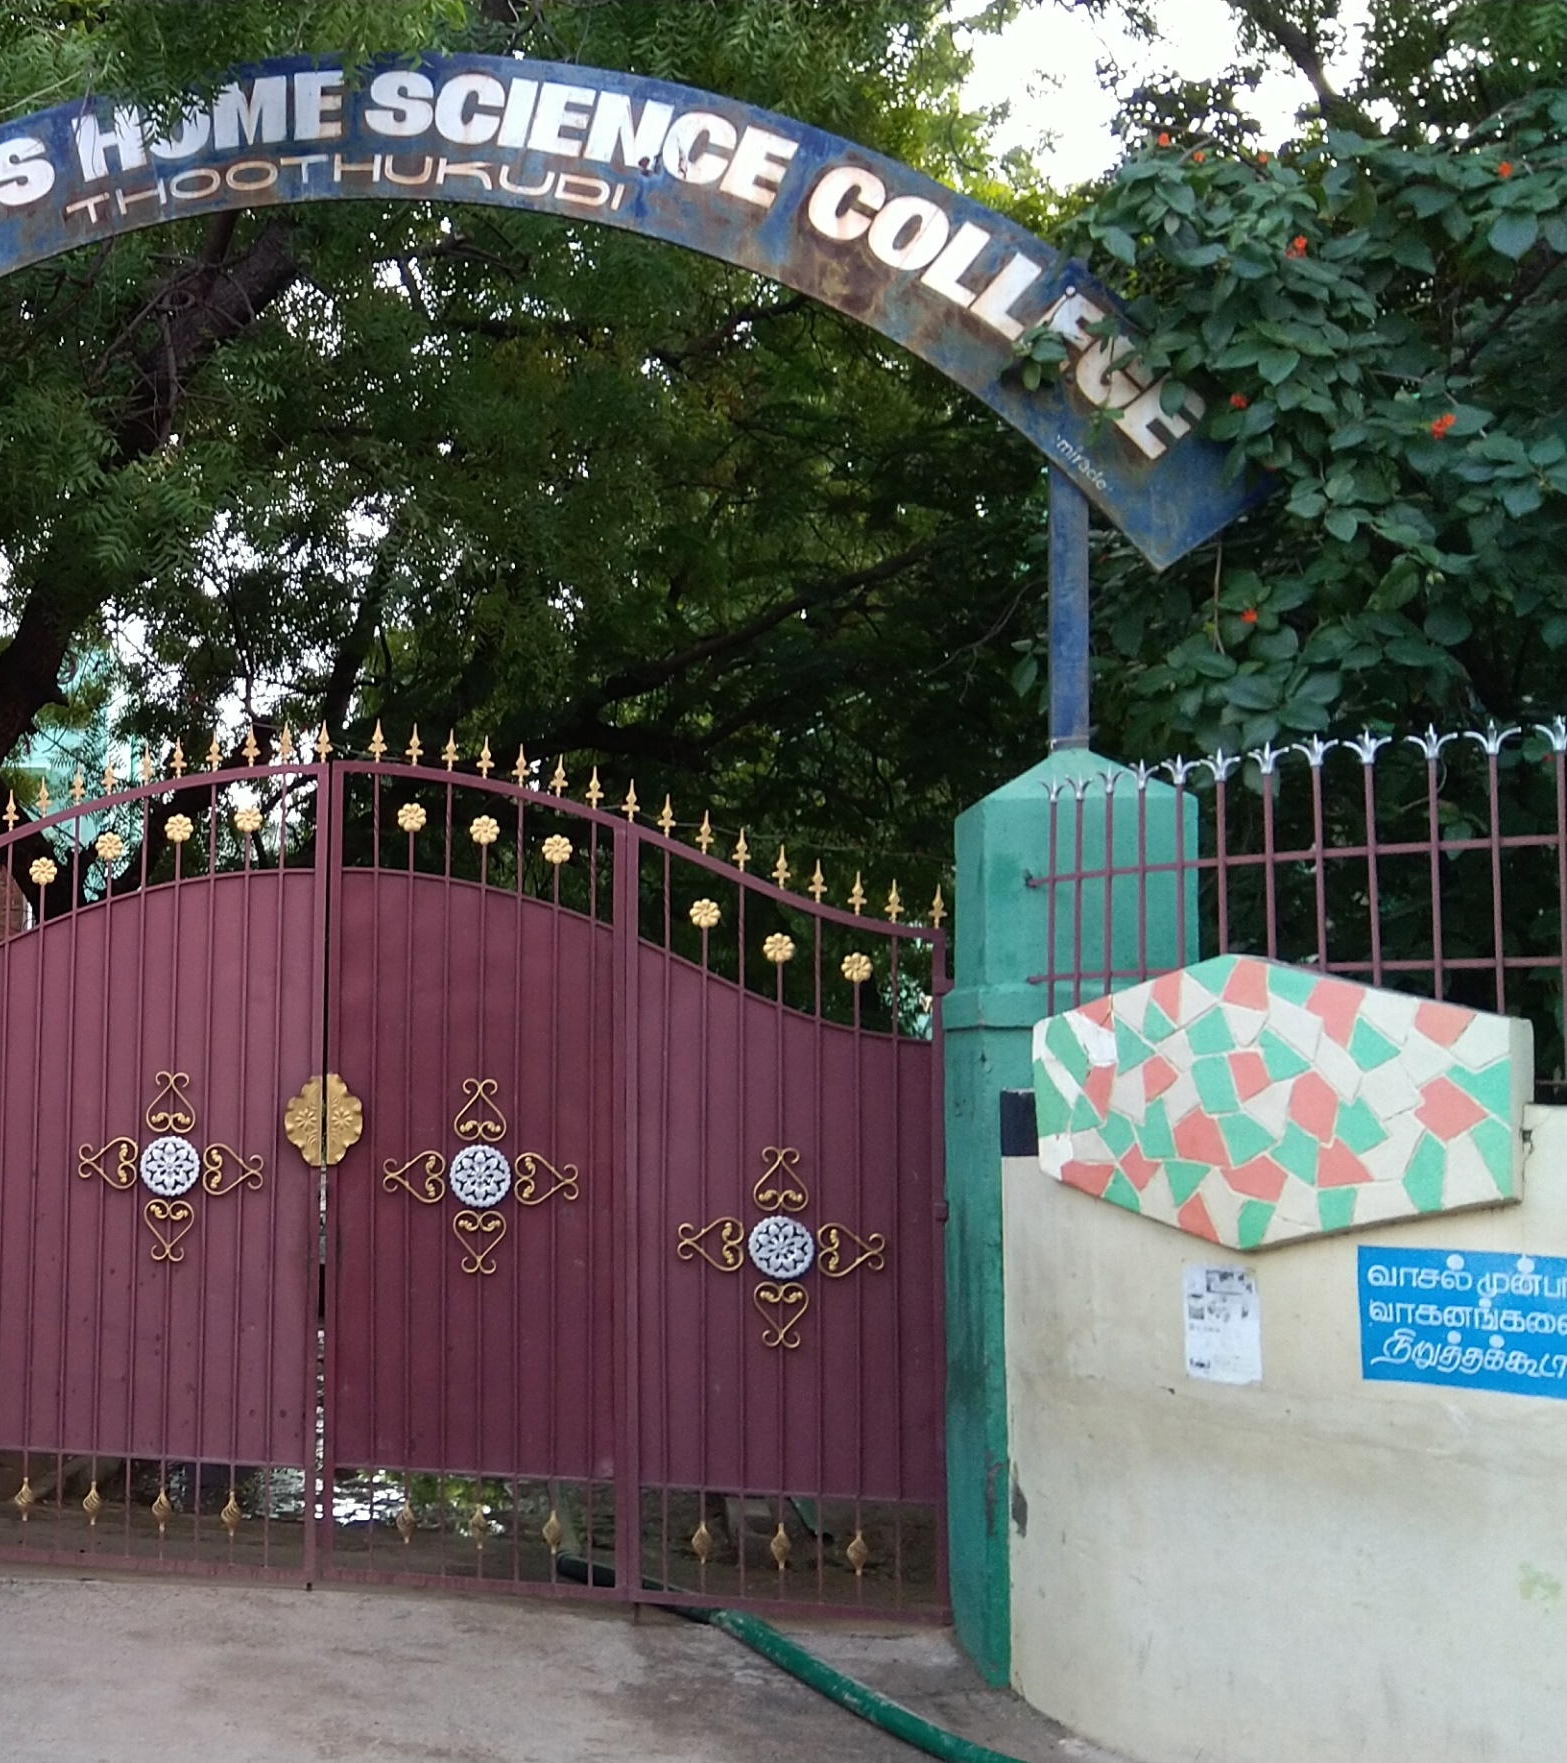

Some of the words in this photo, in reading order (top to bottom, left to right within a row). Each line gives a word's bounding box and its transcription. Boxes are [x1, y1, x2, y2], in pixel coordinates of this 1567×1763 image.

[71, 69, 345, 183] HOME
[365, 70, 801, 209] SCIENCE
[65, 153, 625, 224] THOOTHUKUDI
[1367, 1254, 1473, 1292] வாசல்
